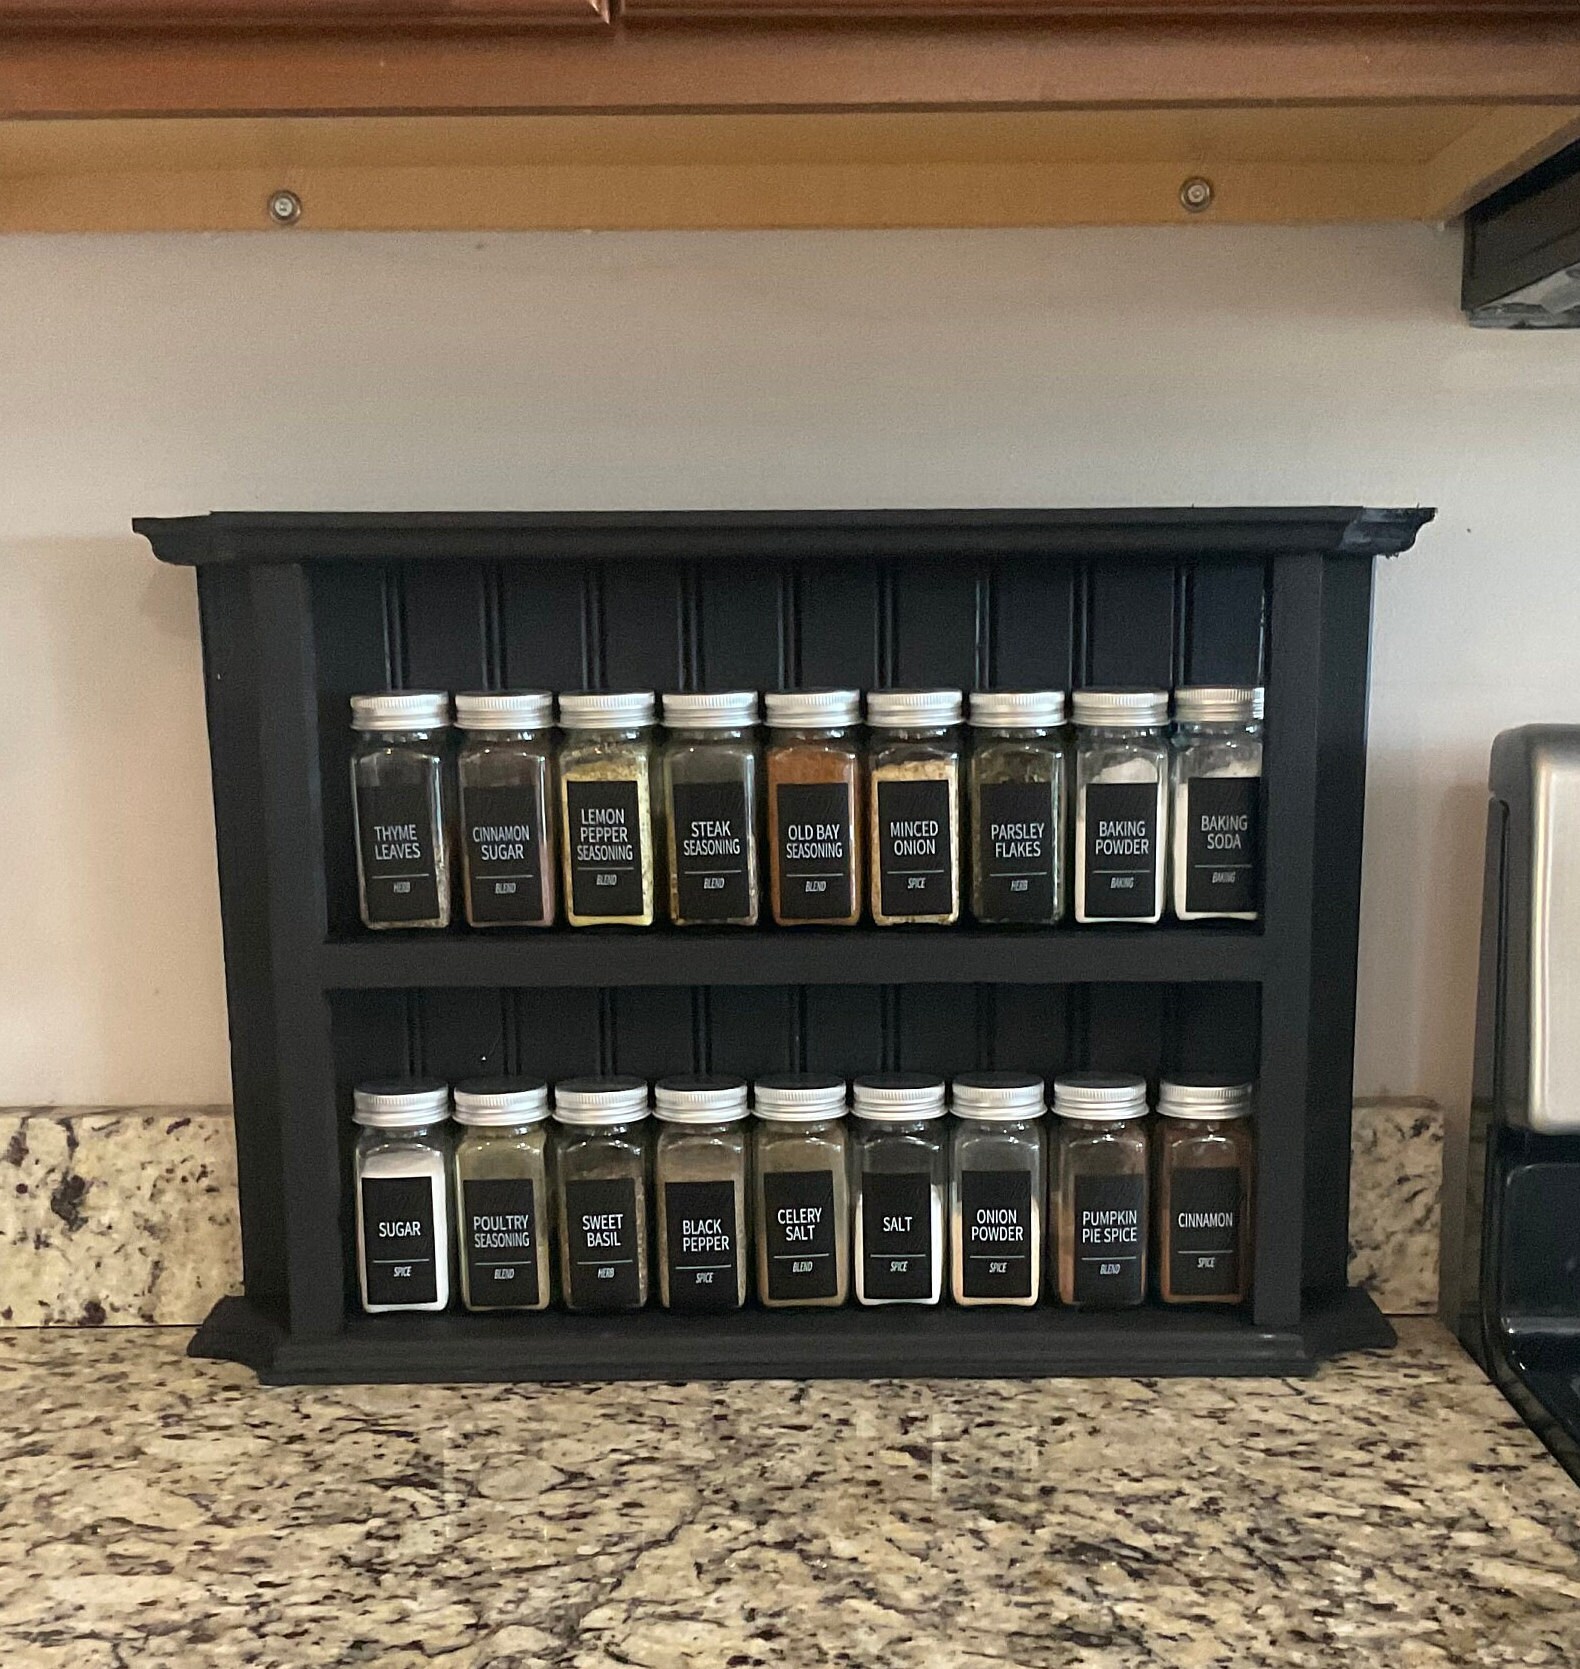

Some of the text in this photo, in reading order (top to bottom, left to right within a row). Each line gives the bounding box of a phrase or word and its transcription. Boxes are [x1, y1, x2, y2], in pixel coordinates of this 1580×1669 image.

[581, 809, 625, 824] LEMON
[1201, 815, 1247, 832] BAKING
[374, 825, 417, 841] THYME
[473, 825, 530, 842] CINNAMON
[580, 827, 628, 842] PEPPER
[691, 821, 730, 837] STEAK
[788, 824, 840, 840] OLD BAY
[890, 821, 938, 837] MINCED
[991, 823, 1044, 840] PARSLEY
[1099, 821, 1146, 837] BAKING
[684, 838, 740, 856] SEASONING
[894, 839, 936, 856] ONION
[996, 841, 1041, 858] FLAKES
[1095, 838, 1149, 854] POWDER
[1207, 834, 1242, 850] SODA
[374, 843, 420, 860] LEAVES
[481, 844, 524, 860] SUGAR
[577, 845, 633, 861] SEASONING
[786, 842, 842, 859] SEASONING
[596, 875, 617, 885] BLEND
[704, 878, 724, 888] BLEND
[908, 878, 926, 888] SPICE
[1011, 880, 1028, 891] HERB
[1111, 877, 1134, 888] BAKING
[1212, 872, 1236, 883] BAKING
[394, 882, 410, 893] HERB
[495, 883, 516, 894] BLEND
[805, 881, 826, 892] BLEND
[473, 1215, 529, 1231] POULTRY
[582, 1214, 623, 1230] SWEET
[777, 1207, 822, 1224] CELERY
[976, 1209, 1017, 1224] ONION
[1082, 1210, 1137, 1226] PUMPKIN
[1178, 1212, 1233, 1228] CINNAMON
[379, 1221, 421, 1237] SUGAR
[682, 1219, 721, 1235] BLACK
[883, 1217, 912, 1232] SALT
[474, 1232, 530, 1248] SEASONING
[587, 1232, 621, 1247] BASIL
[785, 1225, 815, 1241] SALT
[971, 1226, 1023, 1242] POWDER
[1082, 1227, 1137, 1243] PIE SPICE
[683, 1236, 729, 1252] PEPPER
[792, 1261, 812, 1272] BLEND
[890, 1261, 908, 1272] SPICE
[989, 1262, 1007, 1273] SPICE
[1100, 1264, 1120, 1274] BLEND
[1197, 1258, 1215, 1268] SPICE
[394, 1266, 412, 1277] SPICE
[494, 1269, 514, 1279] BLEND
[598, 1267, 614, 1278] HERB
[696, 1273, 714, 1283] SPICE
